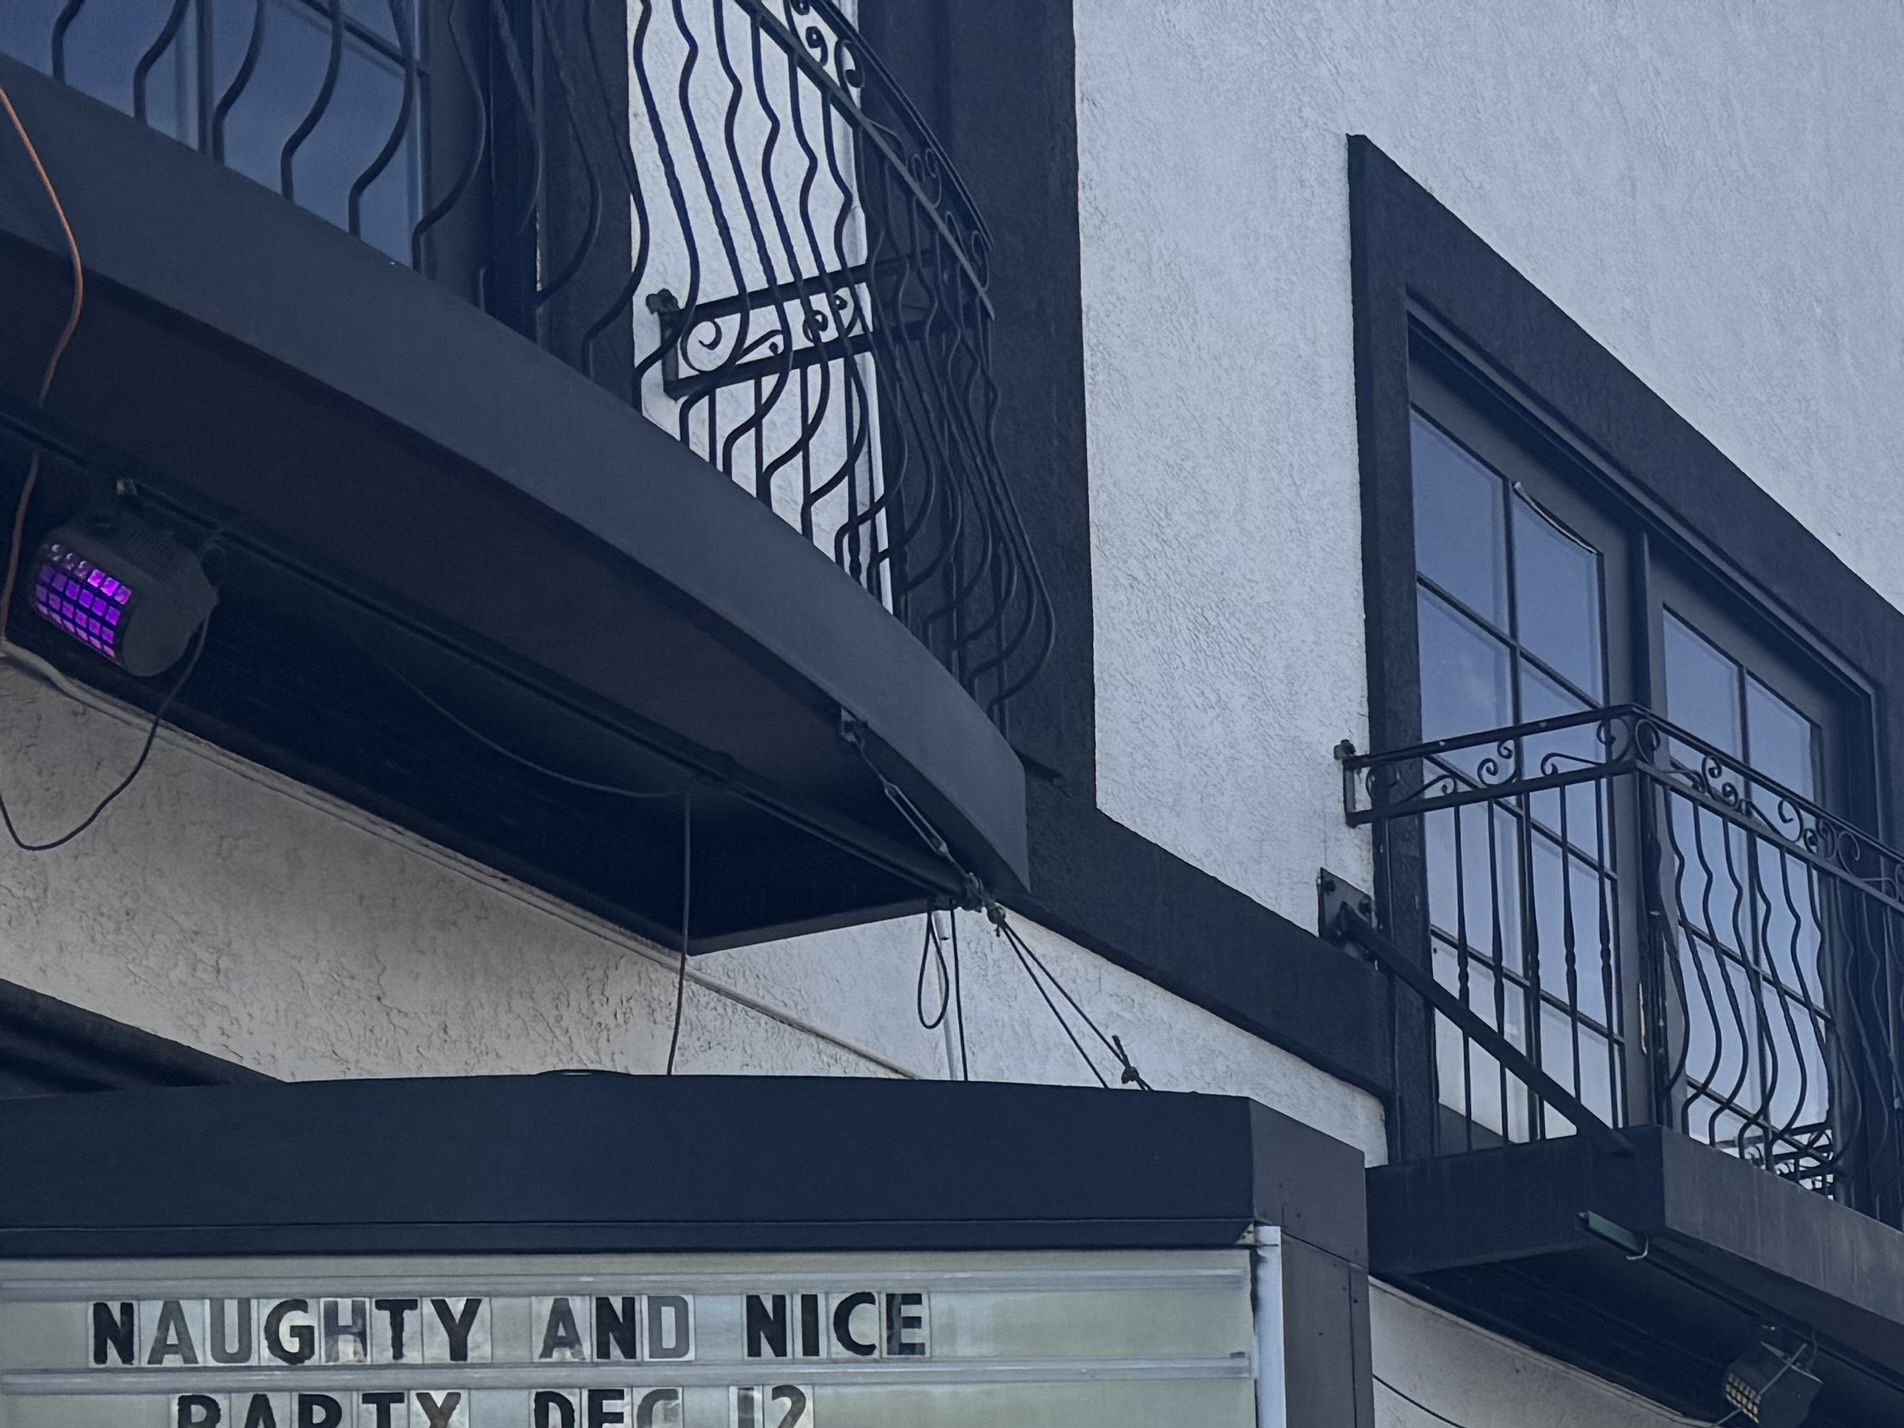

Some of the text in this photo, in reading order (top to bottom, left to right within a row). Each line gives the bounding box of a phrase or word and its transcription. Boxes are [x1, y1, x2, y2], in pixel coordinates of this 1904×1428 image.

[89, 1291, 929, 1367] NAUGHTY AND NICE
